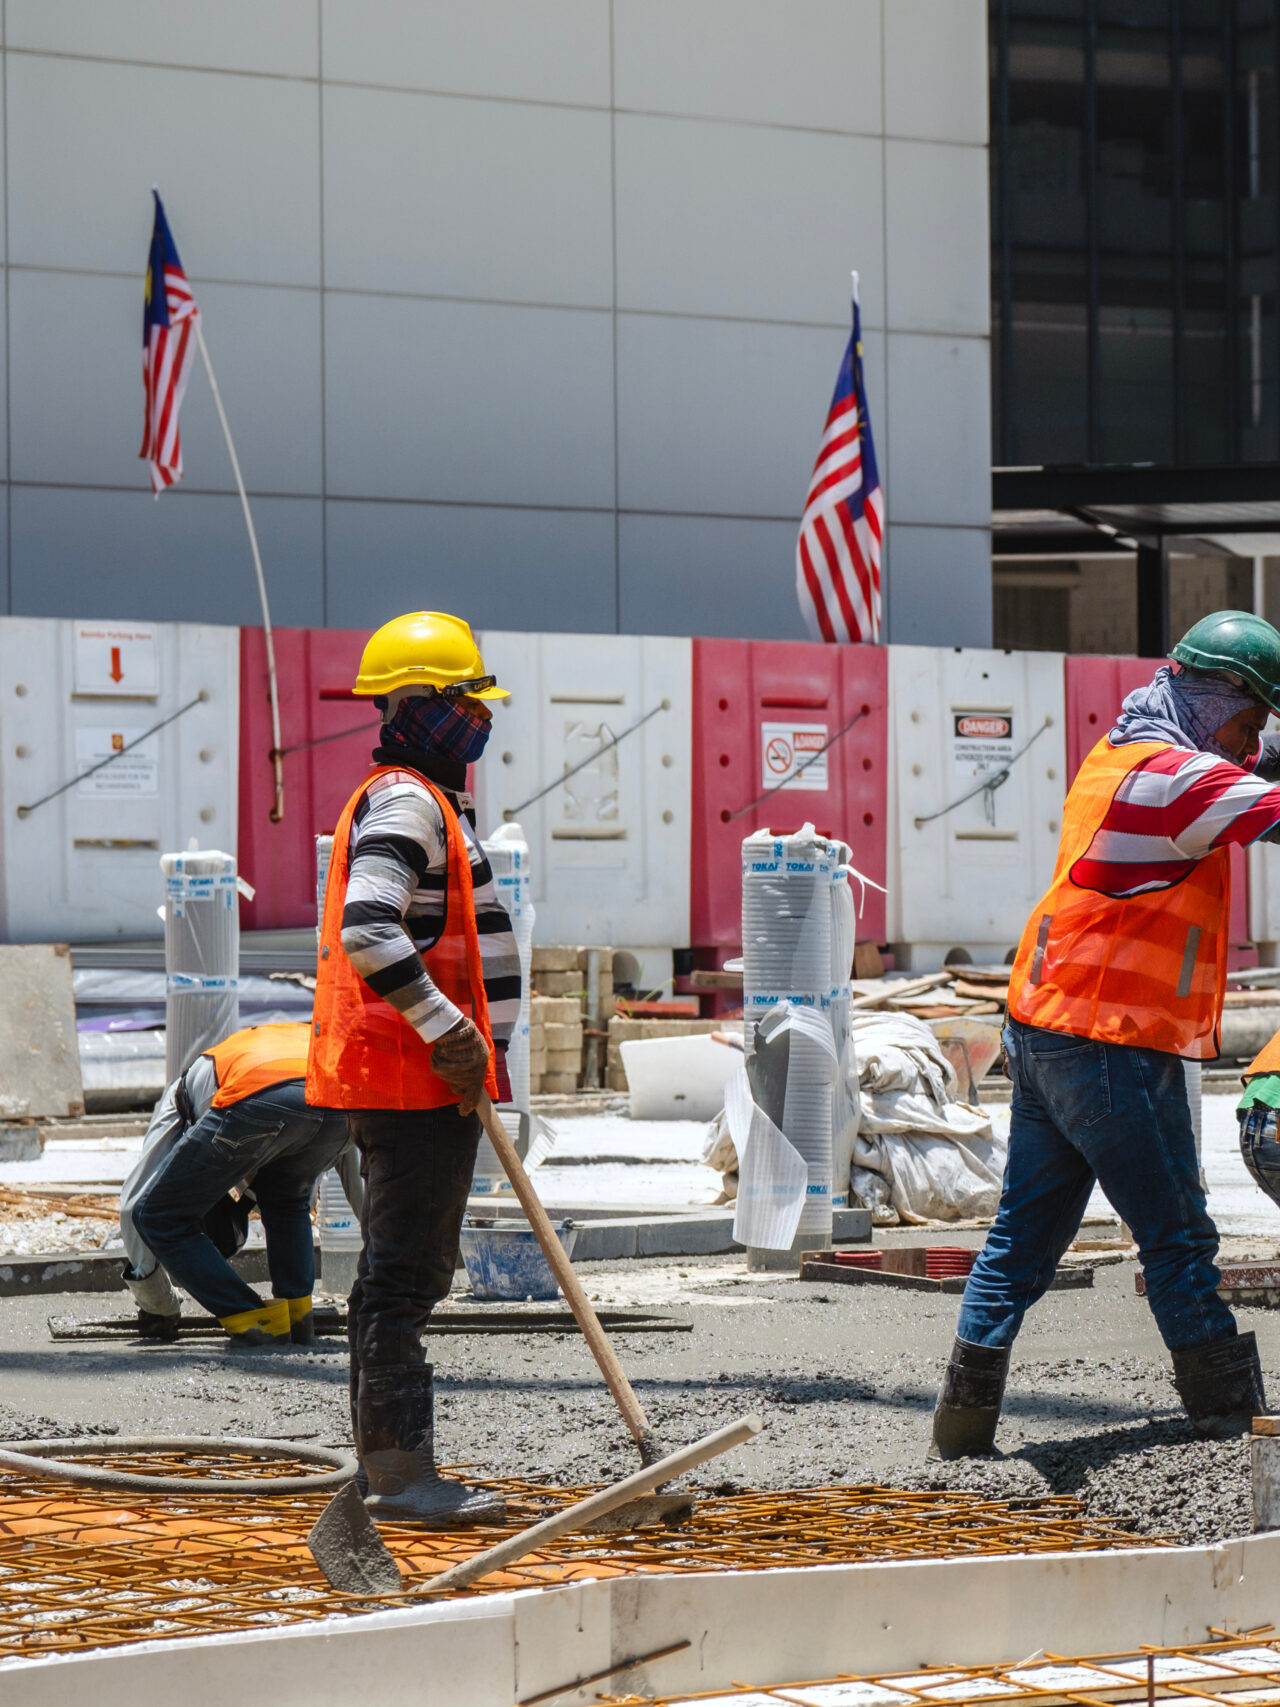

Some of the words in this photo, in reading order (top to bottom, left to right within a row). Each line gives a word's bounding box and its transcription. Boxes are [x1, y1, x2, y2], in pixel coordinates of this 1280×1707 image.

[963, 719, 1003, 734] DANGER
[798, 734, 825, 747] DANGER
[752, 862, 779, 872] TOKAI
[786, 862, 814, 872] TOKAI
[753, 995, 779, 1005] TOKAI
[806, 1185, 828, 1195] TOKAI
